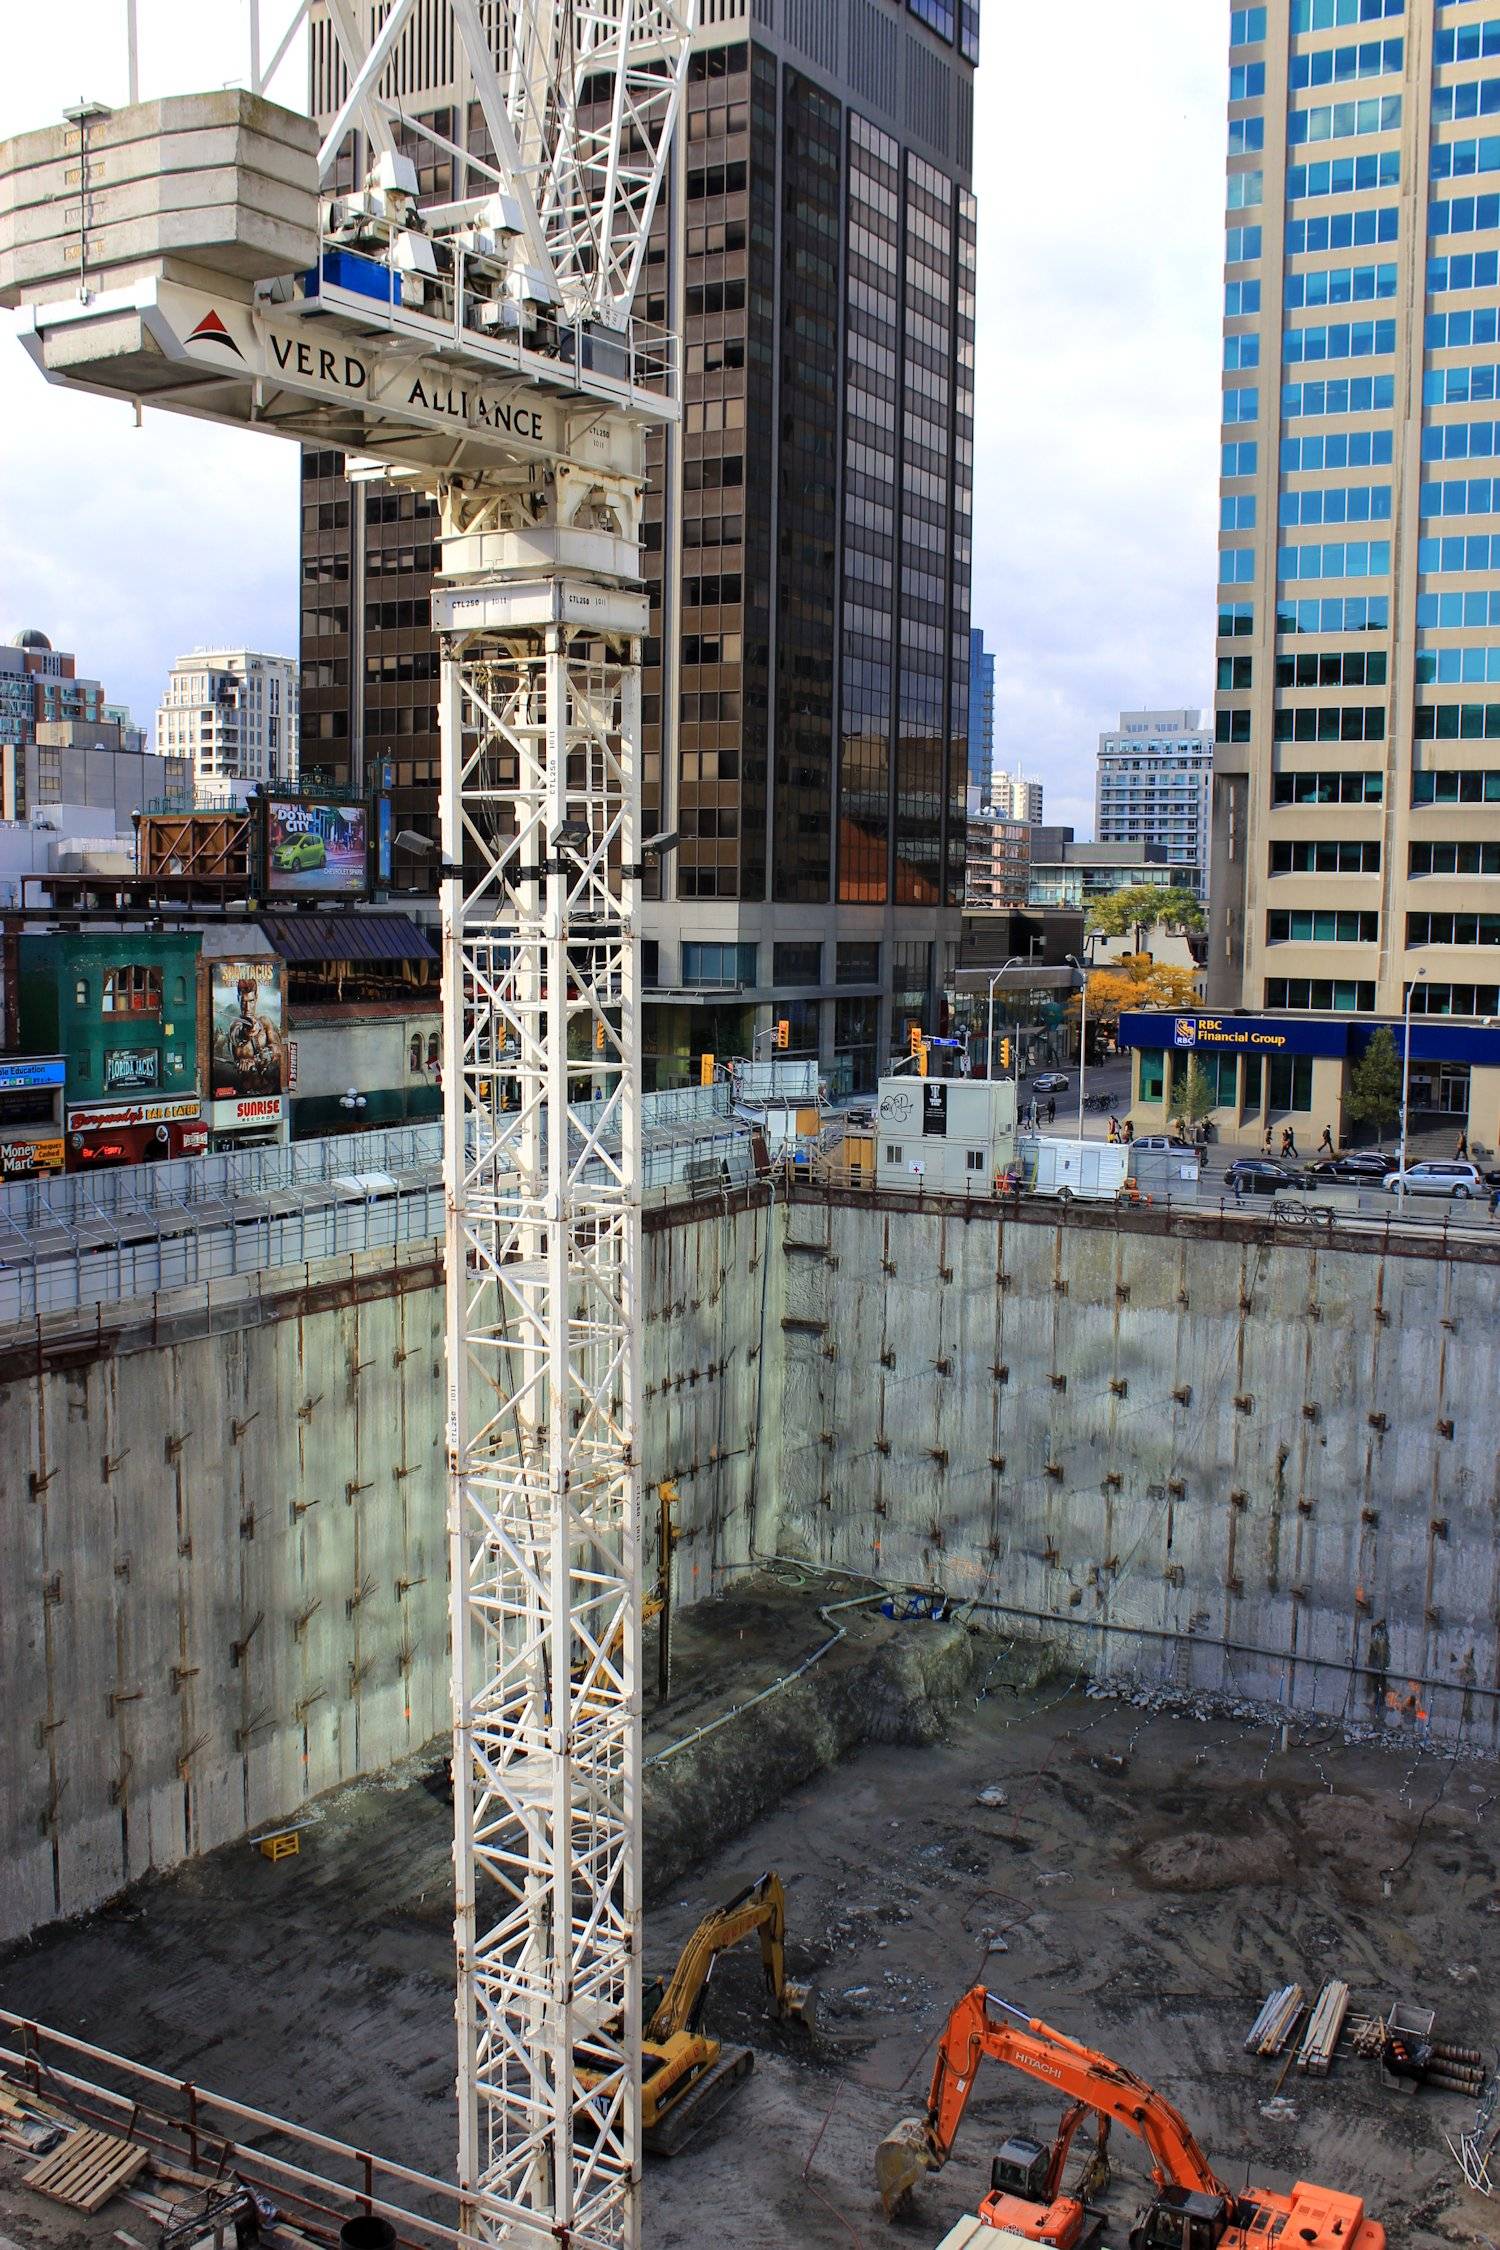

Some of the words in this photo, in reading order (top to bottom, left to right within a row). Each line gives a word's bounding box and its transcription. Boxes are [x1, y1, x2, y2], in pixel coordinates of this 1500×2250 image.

[407, 377, 543, 441] ALLIANCE
[451, 599, 480, 609] CTL250
[277, 809, 296, 821] DO
[297, 810, 314, 822] THE
[286, 820, 310, 833] CITY
[222, 964, 273, 981] SPARTACUS
[1198, 1019, 1223, 1030] RBC
[1197, 1030, 1249, 1043] Financial
[1250, 1032, 1286, 1047] Group
[10, 1065, 46, 1075] Education
[107, 1059, 135, 1081] FLORIDA
[135, 1056, 154, 1077] JACKS
[145, 1108, 162, 1120] BAR
[172, 1103, 200, 1117] EATERY
[237, 1099, 280, 1118] SUNRISE
[0, 1144, 37, 1160] Money
[4, 1158, 33, 1172] Mart
[1015, 2051, 1062, 2079] HITACHI
